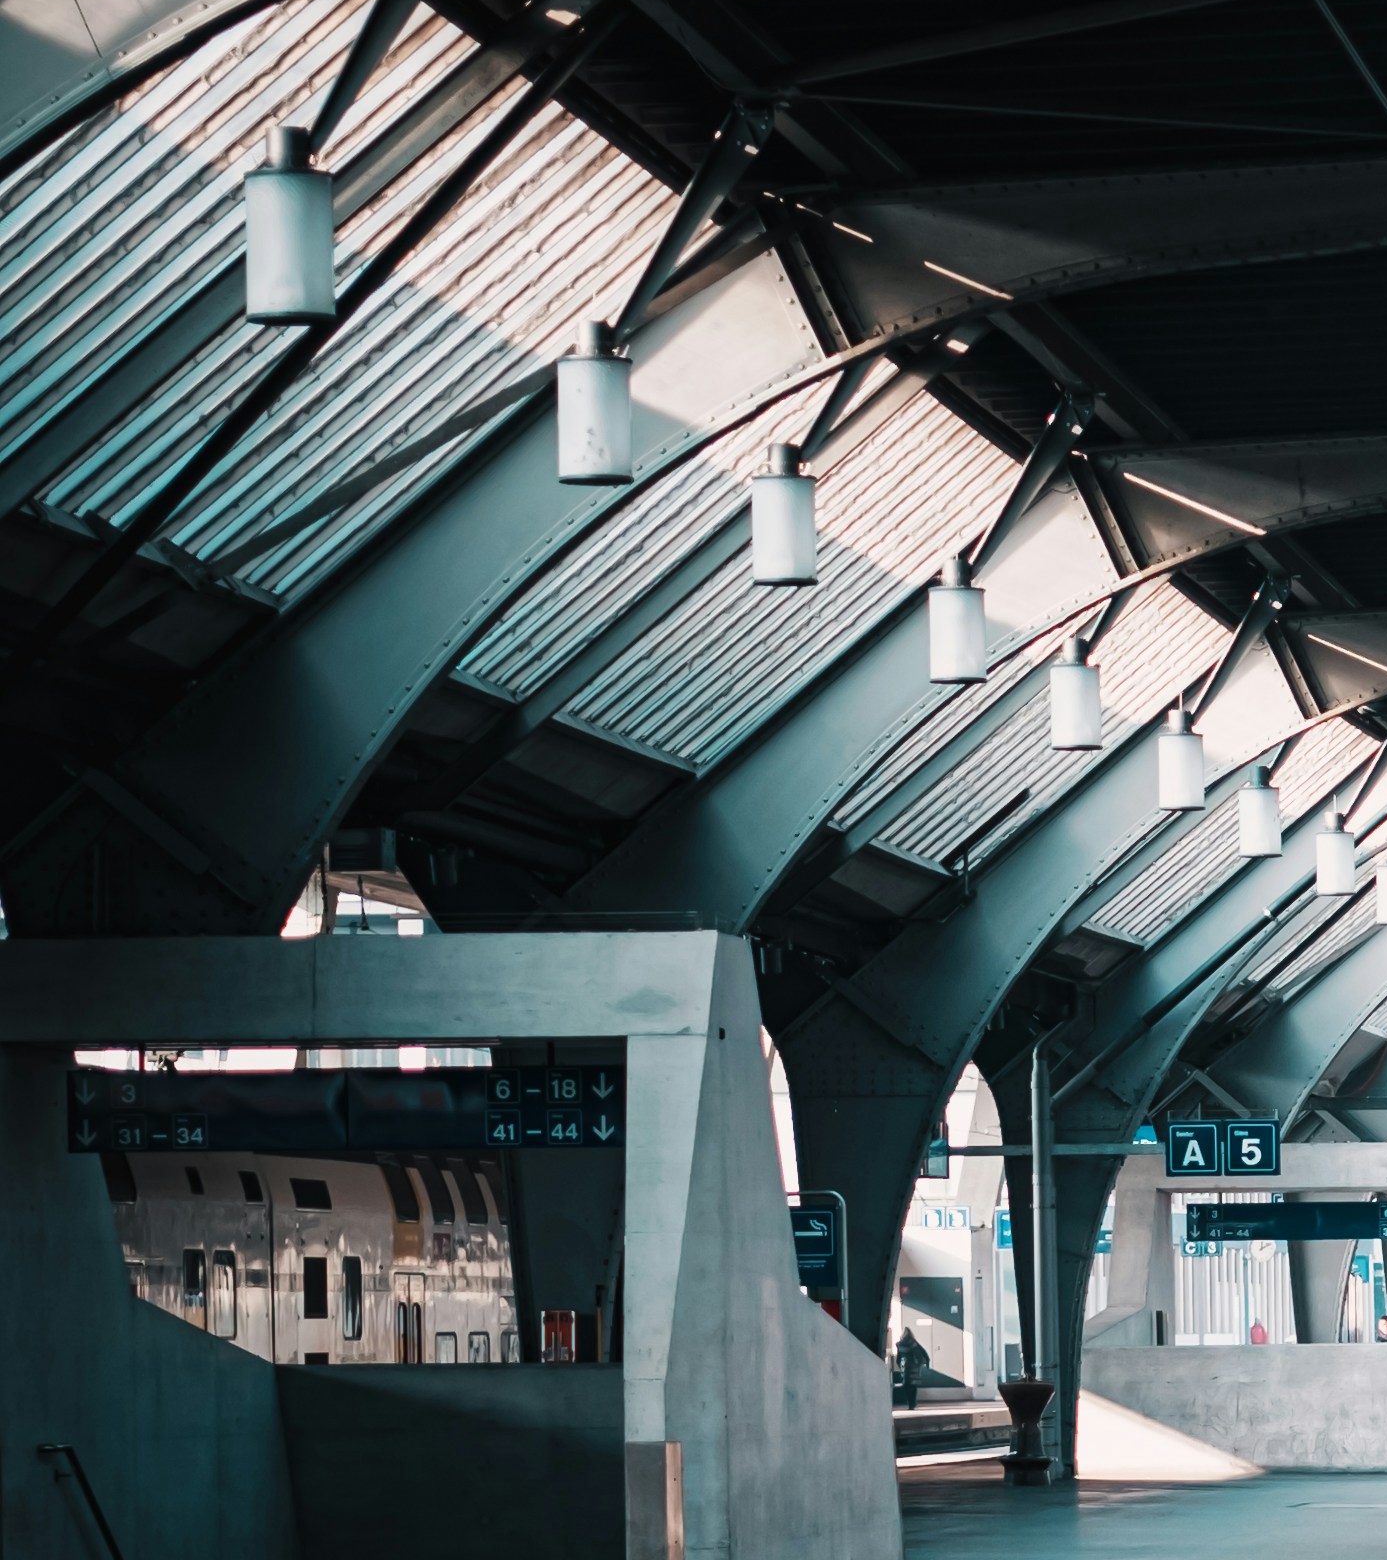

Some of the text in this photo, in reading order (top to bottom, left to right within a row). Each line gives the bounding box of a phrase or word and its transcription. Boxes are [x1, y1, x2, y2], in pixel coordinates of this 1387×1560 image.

[120, 1084, 136, 1103] 3
[495, 1079, 511, 1099] 6
[551, 1079, 576, 1099] 18
[118, 1128, 141, 1145] 31
[176, 1127, 203, 1144] 34
[493, 1123, 515, 1141] 41
[551, 1123, 578, 1140] 44
[1182, 1138, 1262, 1167] A 5
[1211, 1210, 1218, 1219] 3
[1209, 1229, 1221, 1237] 41
[1185, 1241, 1196, 1254] C
